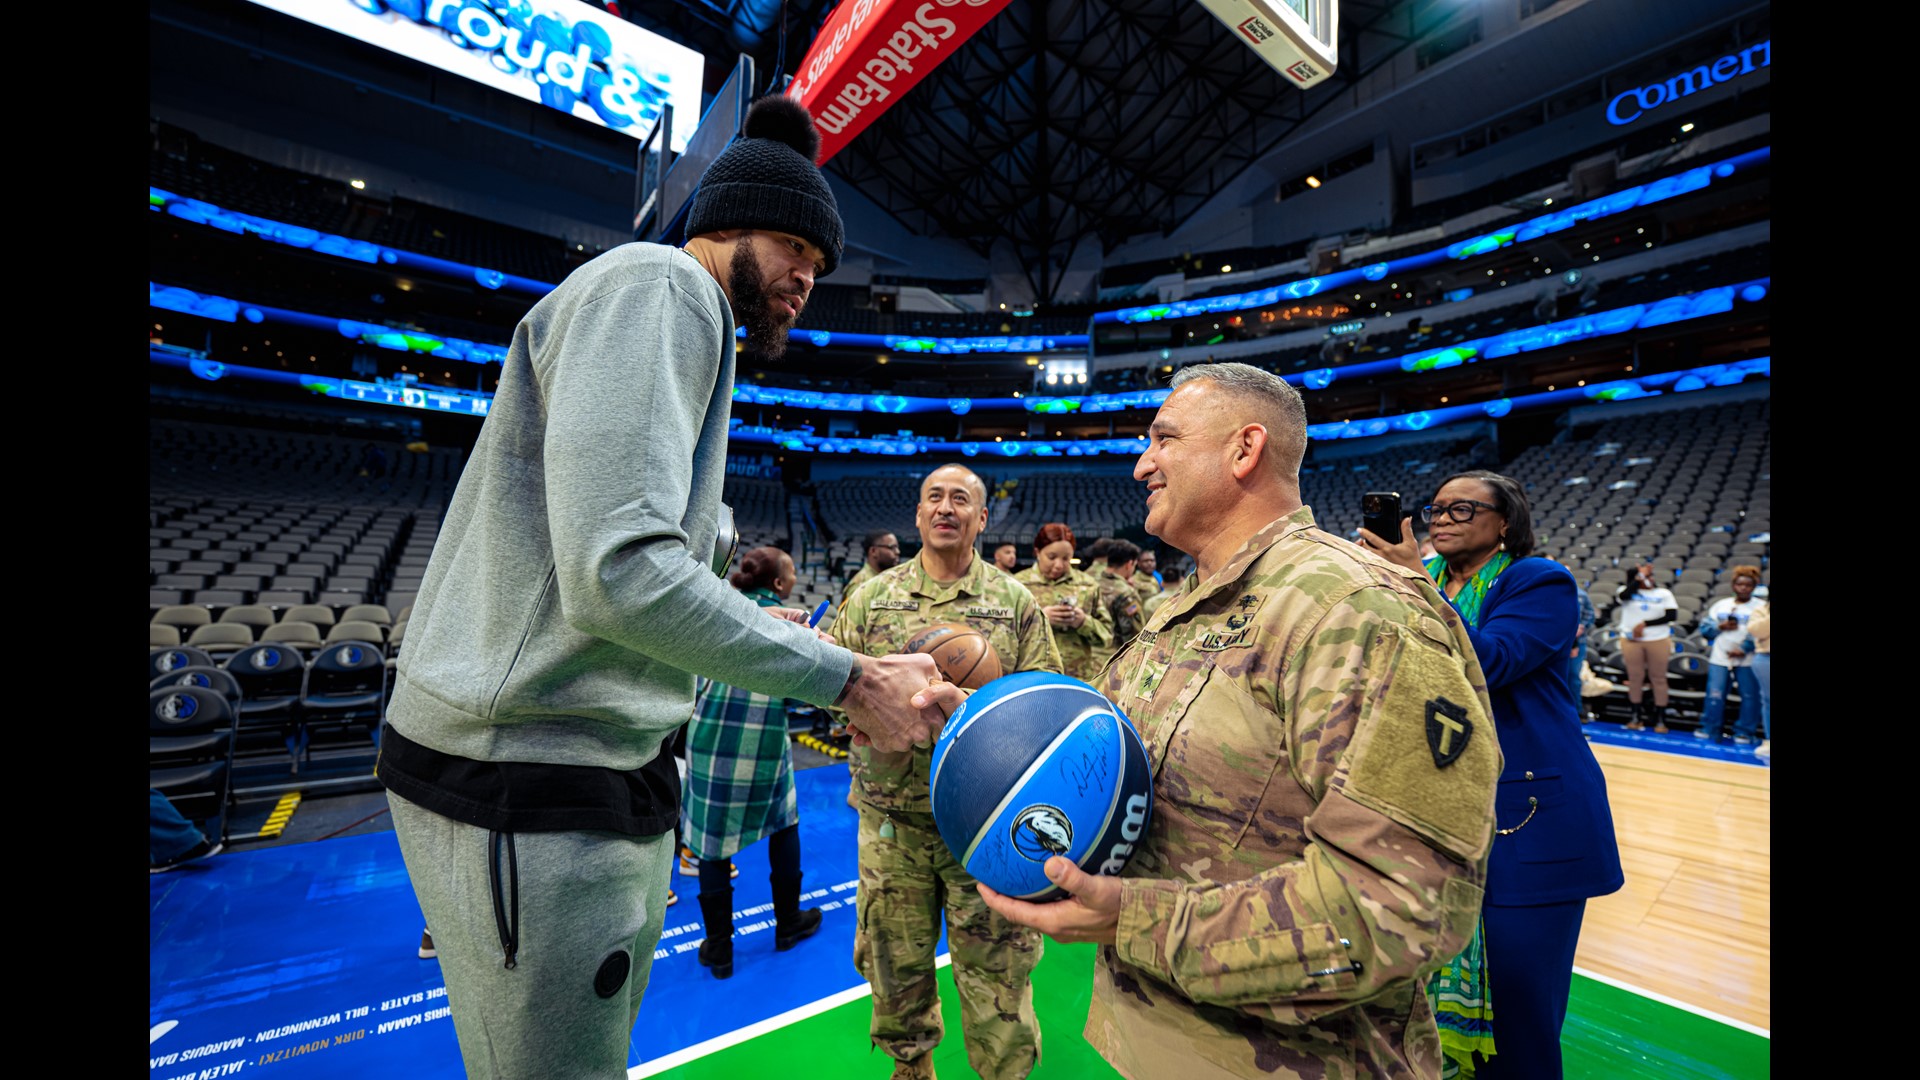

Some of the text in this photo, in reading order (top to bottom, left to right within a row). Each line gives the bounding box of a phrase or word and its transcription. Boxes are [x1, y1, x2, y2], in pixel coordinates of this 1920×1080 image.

[1246, 23, 1268, 41] ACME
[1253, 18, 1275, 37] BRICK
[986, 609, 1009, 617] ARMY
[381, 992, 423, 1011] SLATER
[344, 1005, 369, 1020] BILL
[255, 1012, 341, 1043] WENNINGTON
[377, 1013, 422, 1034] KAMAN
[333, 1028, 365, 1046] DIRK
[179, 1036, 245, 1062] MARQUIS
[258, 1037, 330, 1066] NOWITZKI
[198, 1059, 246, 1080] JALEN
